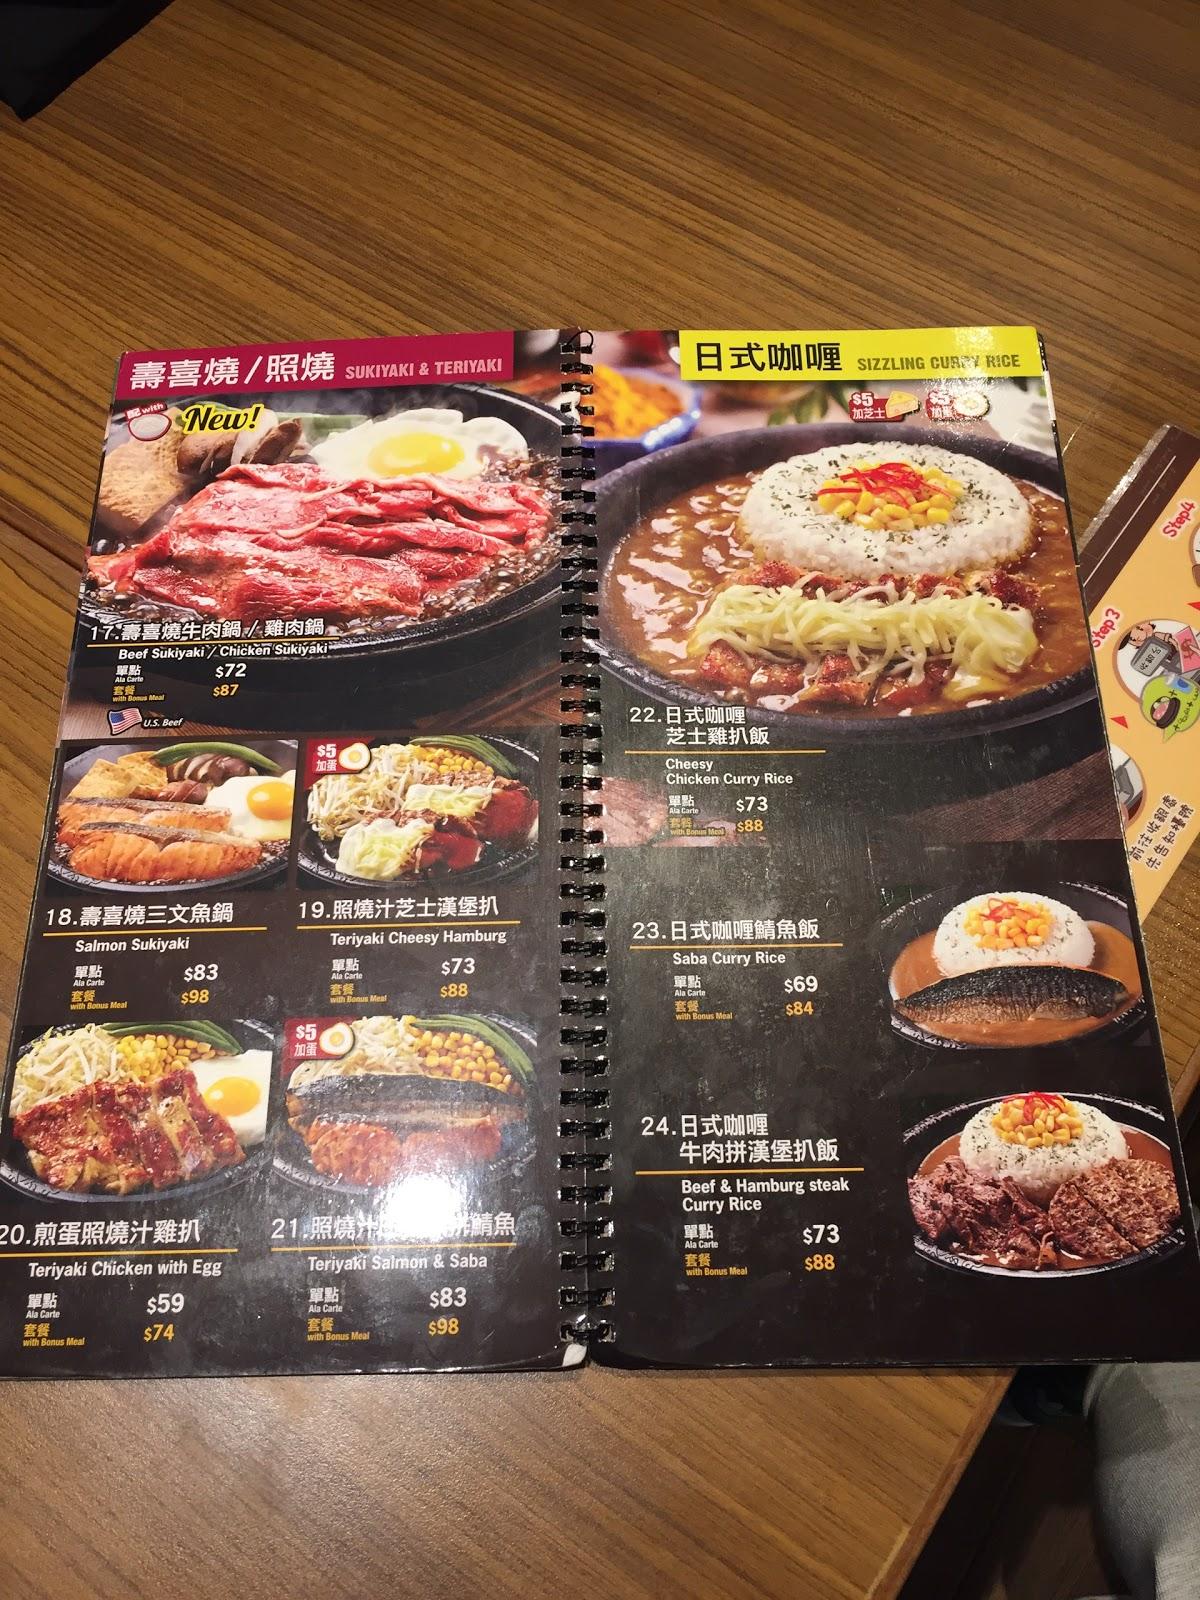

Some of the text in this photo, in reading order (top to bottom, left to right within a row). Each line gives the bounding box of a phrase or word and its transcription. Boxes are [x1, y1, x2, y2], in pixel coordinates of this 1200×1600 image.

[696, 342, 842, 372] 日式咖喱
[857, 356, 925, 371] SIZZLING
[986, 354, 1020, 368] RICE
[345, 363, 414, 380] SUKIYAKI
[419, 363, 430, 376] &
[434, 358, 502, 375] TERIYAKI
[853, 392, 873, 407] $5
[141, 403, 164, 415] with
[853, 408, 886, 419] 加芝士
[184, 406, 262, 432] New!
[1162, 500, 1196, 538] Step4
[248, 620, 259, 638] /
[264, 618, 324, 637] 雞肉鍋
[118, 643, 328, 661] Beef Sukiyaki / Chicken Sukiyaki
[115, 663, 247, 679] 單點 $72
[113, 683, 239, 698] 套餐 $87
[143, 718, 184, 727] U.S. Beef
[666, 726, 770, 745] 芝士雞扒飯
[317, 744, 337, 758] $5
[316, 759, 337, 772] 加蛋
[666, 758, 713, 771] Cheesy
[666, 773, 793, 786] Chicken Curry Rice
[668, 795, 768, 812] 單點 $73
[670, 818, 764, 833] 套餐 $88
[75, 937, 190, 953] Salmon Sukiyaki
[330, 930, 507, 947] Teriyaki Cheesy Hamburg
[332, 958, 476, 976] 單點 $73
[673, 951, 786, 967] Saba Curry Rice
[73, 964, 219, 982] 單點 $83
[73, 978, 105, 987] Ala Carte
[330, 983, 468, 998] 套餐 $88
[674, 975, 818, 994] 單點 $69
[70, 989, 210, 1005] 套餐 $98
[70, 1001, 127, 1010] with Bonus Meal
[675, 1000, 814, 1016] 套餐 $84
[295, 1023, 317, 1041] $5
[294, 1042, 317, 1056] 加蛋
[679, 1138, 840, 1164] 牛肉拼漢堡扒飯
[681, 1177, 850, 1195] Beef & Hamburg steak
[682, 1197, 762, 1214] Curry Rice
[684, 1224, 840, 1245] 單點 $73
[684, 1240, 719, 1248] Ala Carte
[28, 1259, 222, 1280] Teriyaki Chicken with Egg
[307, 1253, 488, 1274] Teriyaki Salmon & Saba
[685, 1253, 835, 1271] 套餐 $88
[686, 1266, 748, 1276] with Bonus Meal
[27, 1292, 185, 1315] 單點 $59
[308, 1286, 467, 1309] 單點 $83
[26, 1310, 60, 1318] Ala Carte
[308, 1304, 343, 1313] Ala Carte
[23, 1323, 175, 1342] 套餐 $74
[307, 1317, 460, 1336] 套餐 $98
[22, 1337, 85, 1347] with Bonus Meal
[307, 1331, 370, 1341] with Bonus Meal
